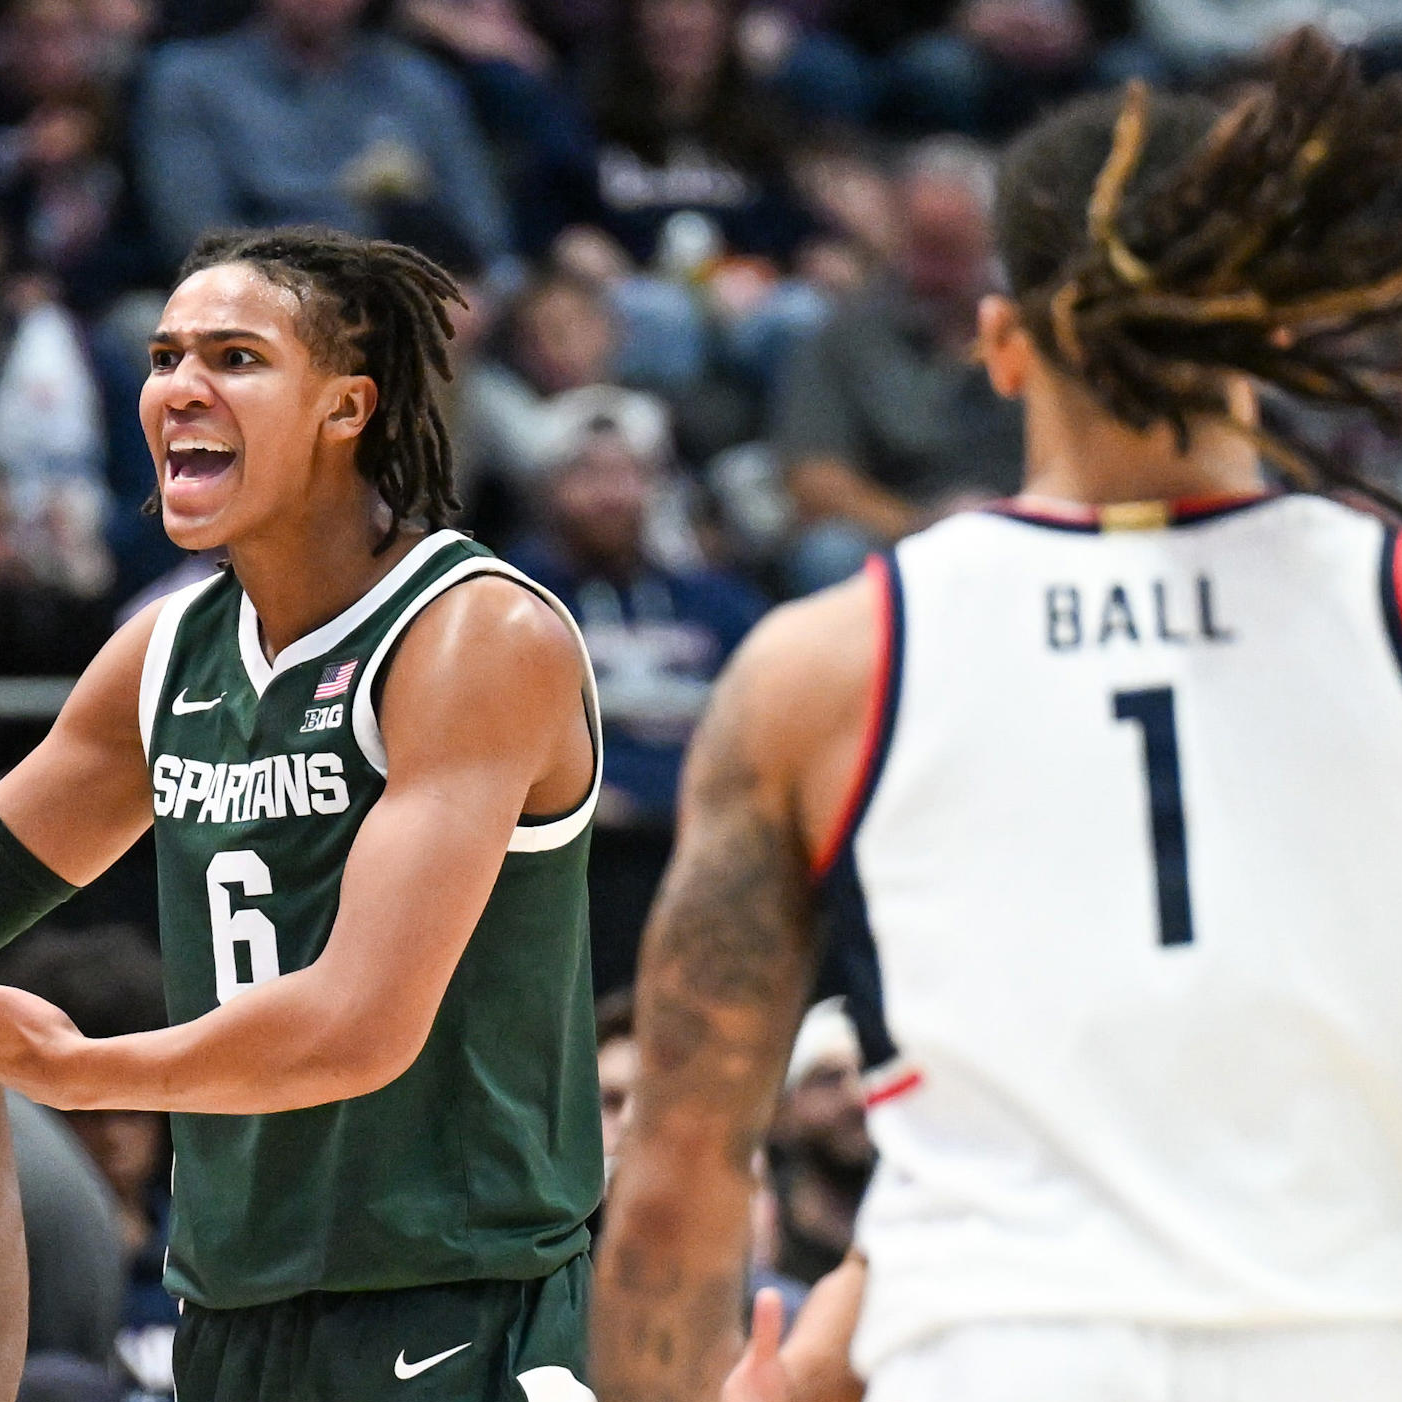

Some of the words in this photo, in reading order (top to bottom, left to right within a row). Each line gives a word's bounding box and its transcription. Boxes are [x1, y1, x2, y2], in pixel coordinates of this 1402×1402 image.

[1045, 573, 1239, 651] BALL
[153, 753, 350, 824] SPARTANS
[1110, 685, 1194, 948] 1
[206, 850, 280, 1006] 6
